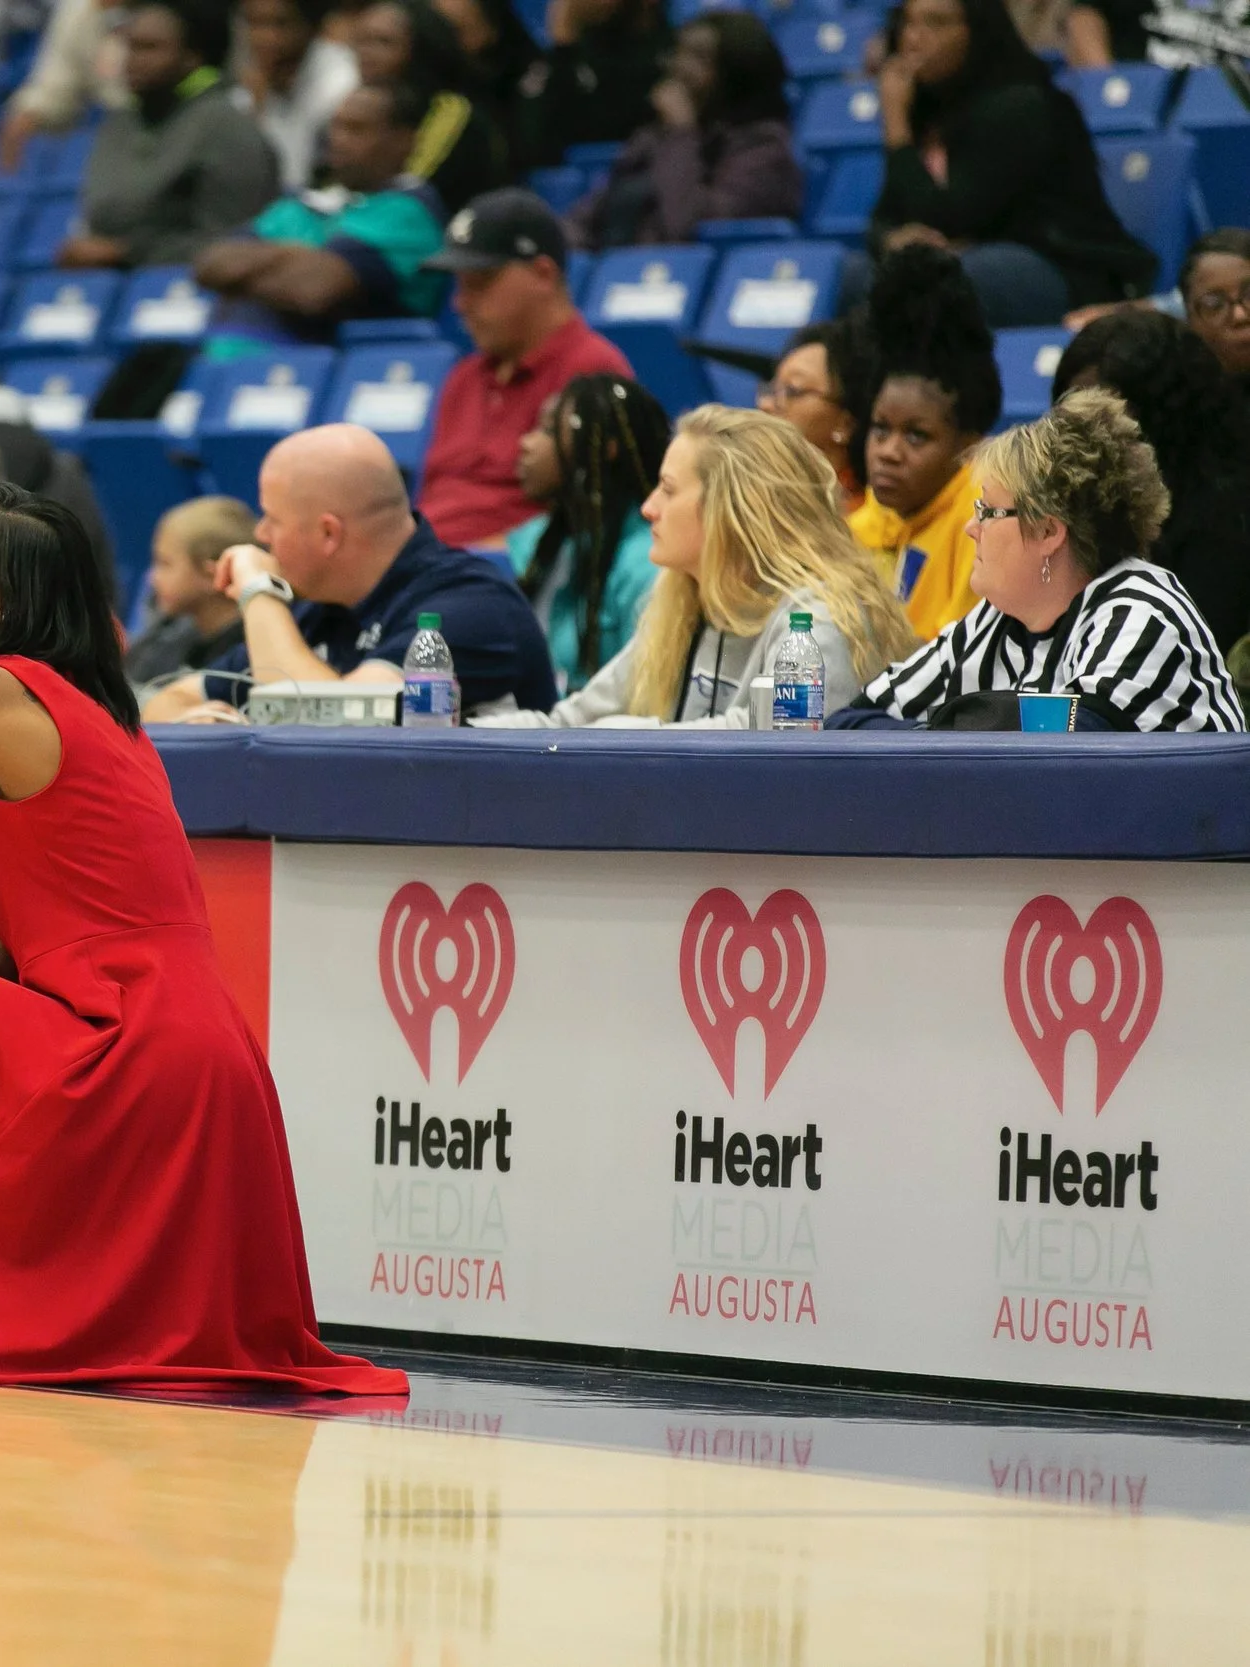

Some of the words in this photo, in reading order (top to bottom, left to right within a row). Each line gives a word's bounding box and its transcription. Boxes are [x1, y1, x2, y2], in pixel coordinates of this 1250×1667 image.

[374, 1096, 512, 1173] iHeart
[674, 1110, 823, 1191] iHeart
[998, 1126, 1159, 1211] iHeart
[372, 1180, 508, 1246] MEDIA
[670, 1197, 818, 1267] MEDIA
[370, 1252, 506, 1302] AUGUSTA
[994, 1217, 1152, 1288] MEDIA
[669, 1273, 817, 1326] AUGUSTA
[993, 1296, 1153, 1351] AUGUSTA
